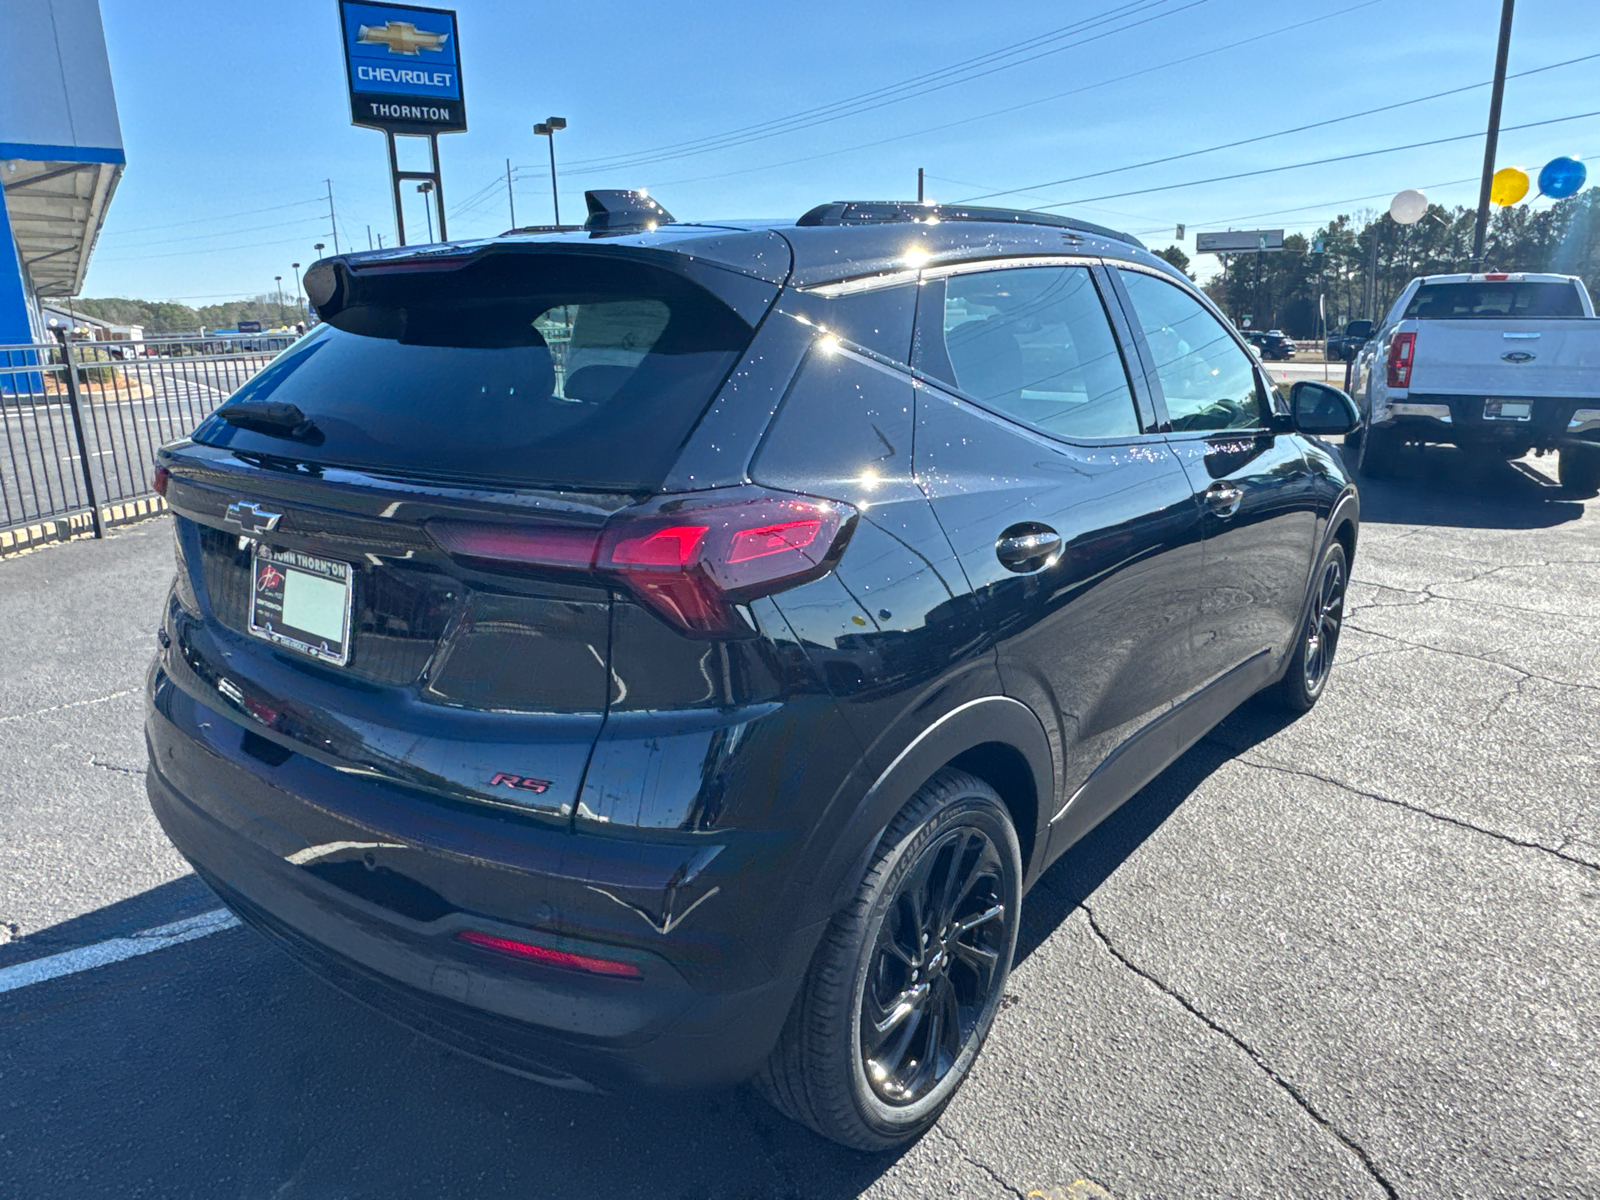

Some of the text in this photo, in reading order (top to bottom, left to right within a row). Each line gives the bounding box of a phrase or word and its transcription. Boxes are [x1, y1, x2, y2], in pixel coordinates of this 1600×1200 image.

[358, 66, 452, 87] CHEVROLET
[370, 103, 450, 120] THORNTON
[273, 551, 346, 578] JOHN THORNTON
[280, 637, 309, 653] CHEVROLET
[490, 772, 554, 795] RS
[887, 817, 938, 888] MICHELIN
